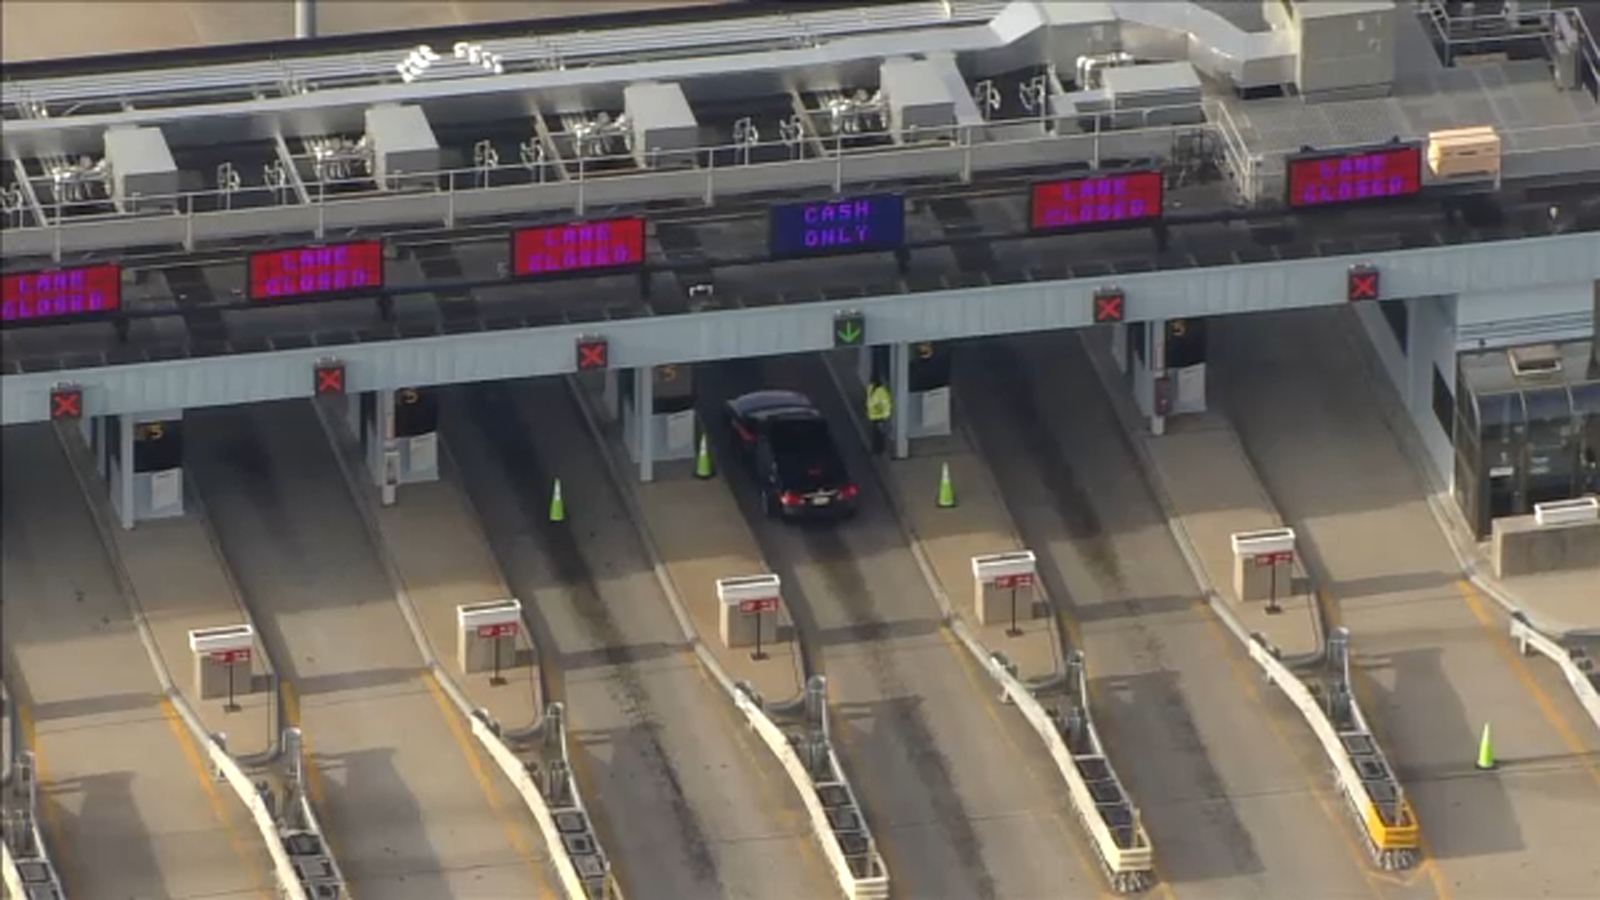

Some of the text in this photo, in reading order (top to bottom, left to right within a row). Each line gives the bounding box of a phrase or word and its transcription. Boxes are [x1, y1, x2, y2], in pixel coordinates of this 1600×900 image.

[1320, 155, 1386, 178] LANE
[1062, 178, 1128, 200] LANE
[1304, 176, 1405, 202] CLOSED
[804, 202, 870, 223] CASH
[1046, 200, 1145, 225] CLOSED
[545, 223, 611, 245] LANE
[804, 225, 868, 247] ONLY
[281, 246, 347, 270] LANE
[528, 246, 629, 271] CLOSED
[19, 270, 84, 294] LANE
[265, 269, 367, 295] CLOSED
[2, 291, 104, 319] CLOSED
